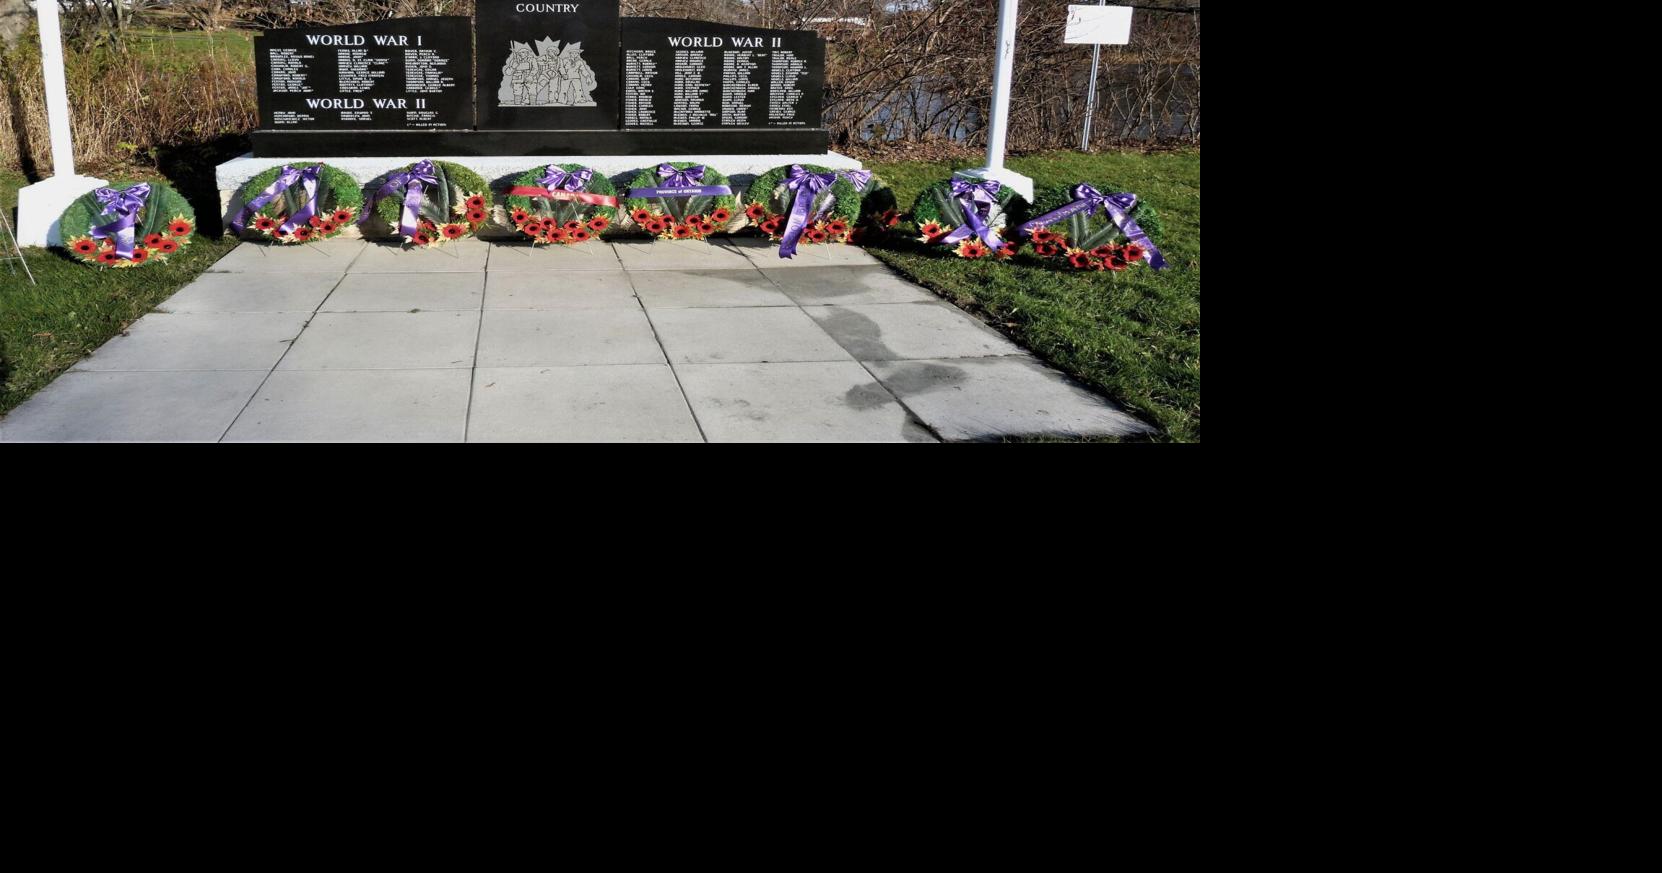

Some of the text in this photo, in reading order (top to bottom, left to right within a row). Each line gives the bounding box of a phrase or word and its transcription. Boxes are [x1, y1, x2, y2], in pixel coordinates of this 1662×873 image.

[515, 3, 579, 13] COUNTRY
[305, 34, 422, 46] WORLD WAR I
[667, 36, 782, 48] WORLD WAR II
[305, 98, 426, 109] WORLD WAR II
